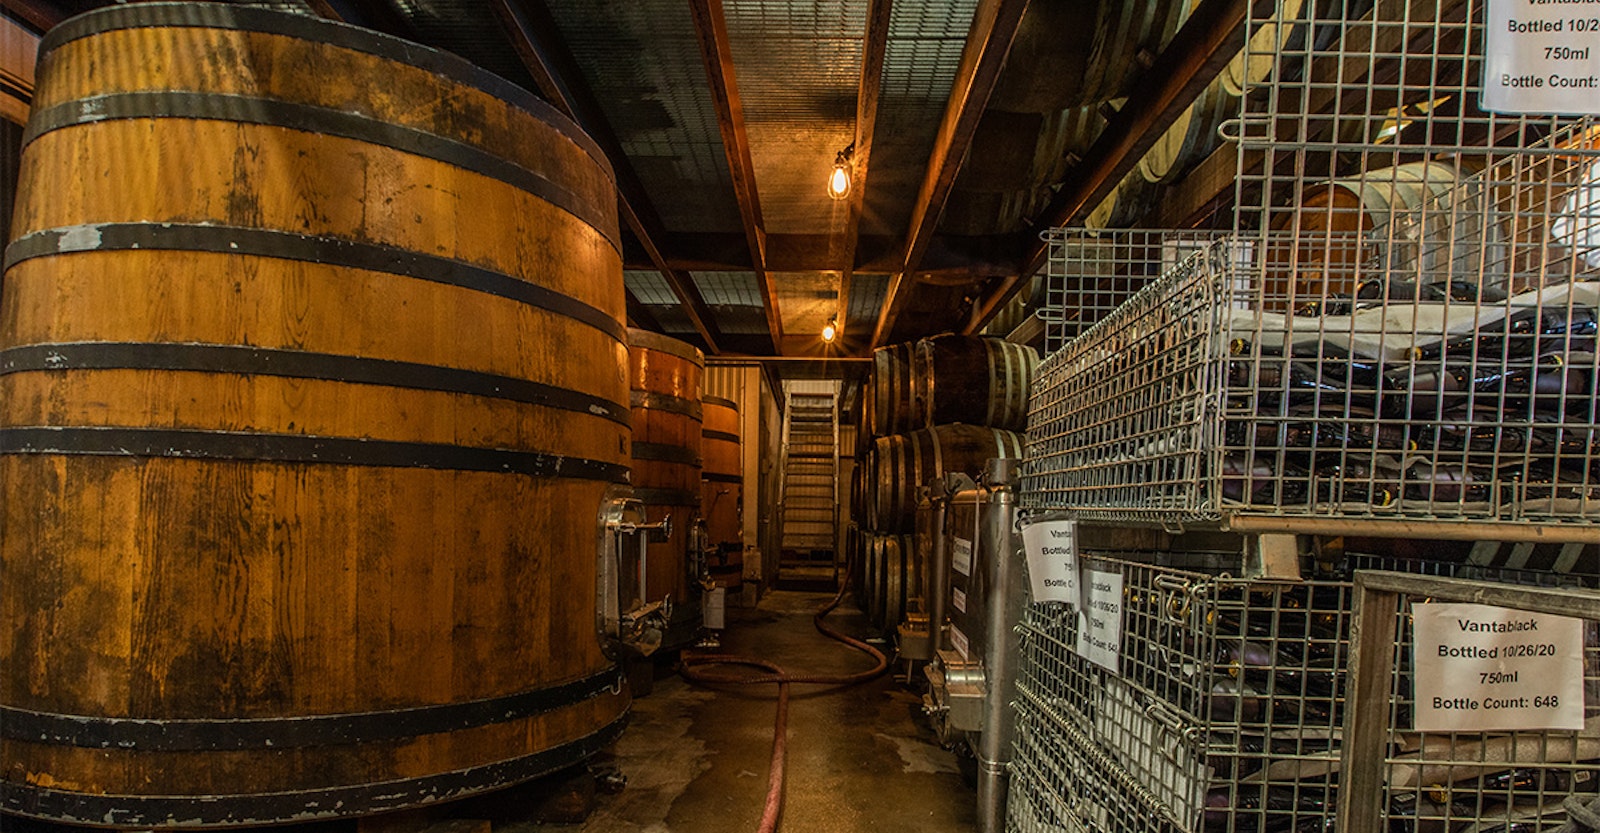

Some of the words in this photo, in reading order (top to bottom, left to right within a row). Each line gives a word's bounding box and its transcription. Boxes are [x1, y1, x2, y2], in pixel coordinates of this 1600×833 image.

[1508, 19, 1563, 33] Bottled
[1568, 18, 1600, 32] 10/2
[1544, 47, 1589, 60] 750ml
[1502, 74, 1543, 88] Bottle
[1549, 74, 1598, 88] Count:
[1458, 619, 1538, 633] Vantablack
[1438, 645, 1498, 659] Bottled
[1502, 644, 1555, 657] 10/26/20
[1480, 671, 1518, 684] 750ml
[1433, 697, 1479, 710] Bottle
[1483, 697, 1528, 710] Count:
[1534, 696, 1559, 708] 648
